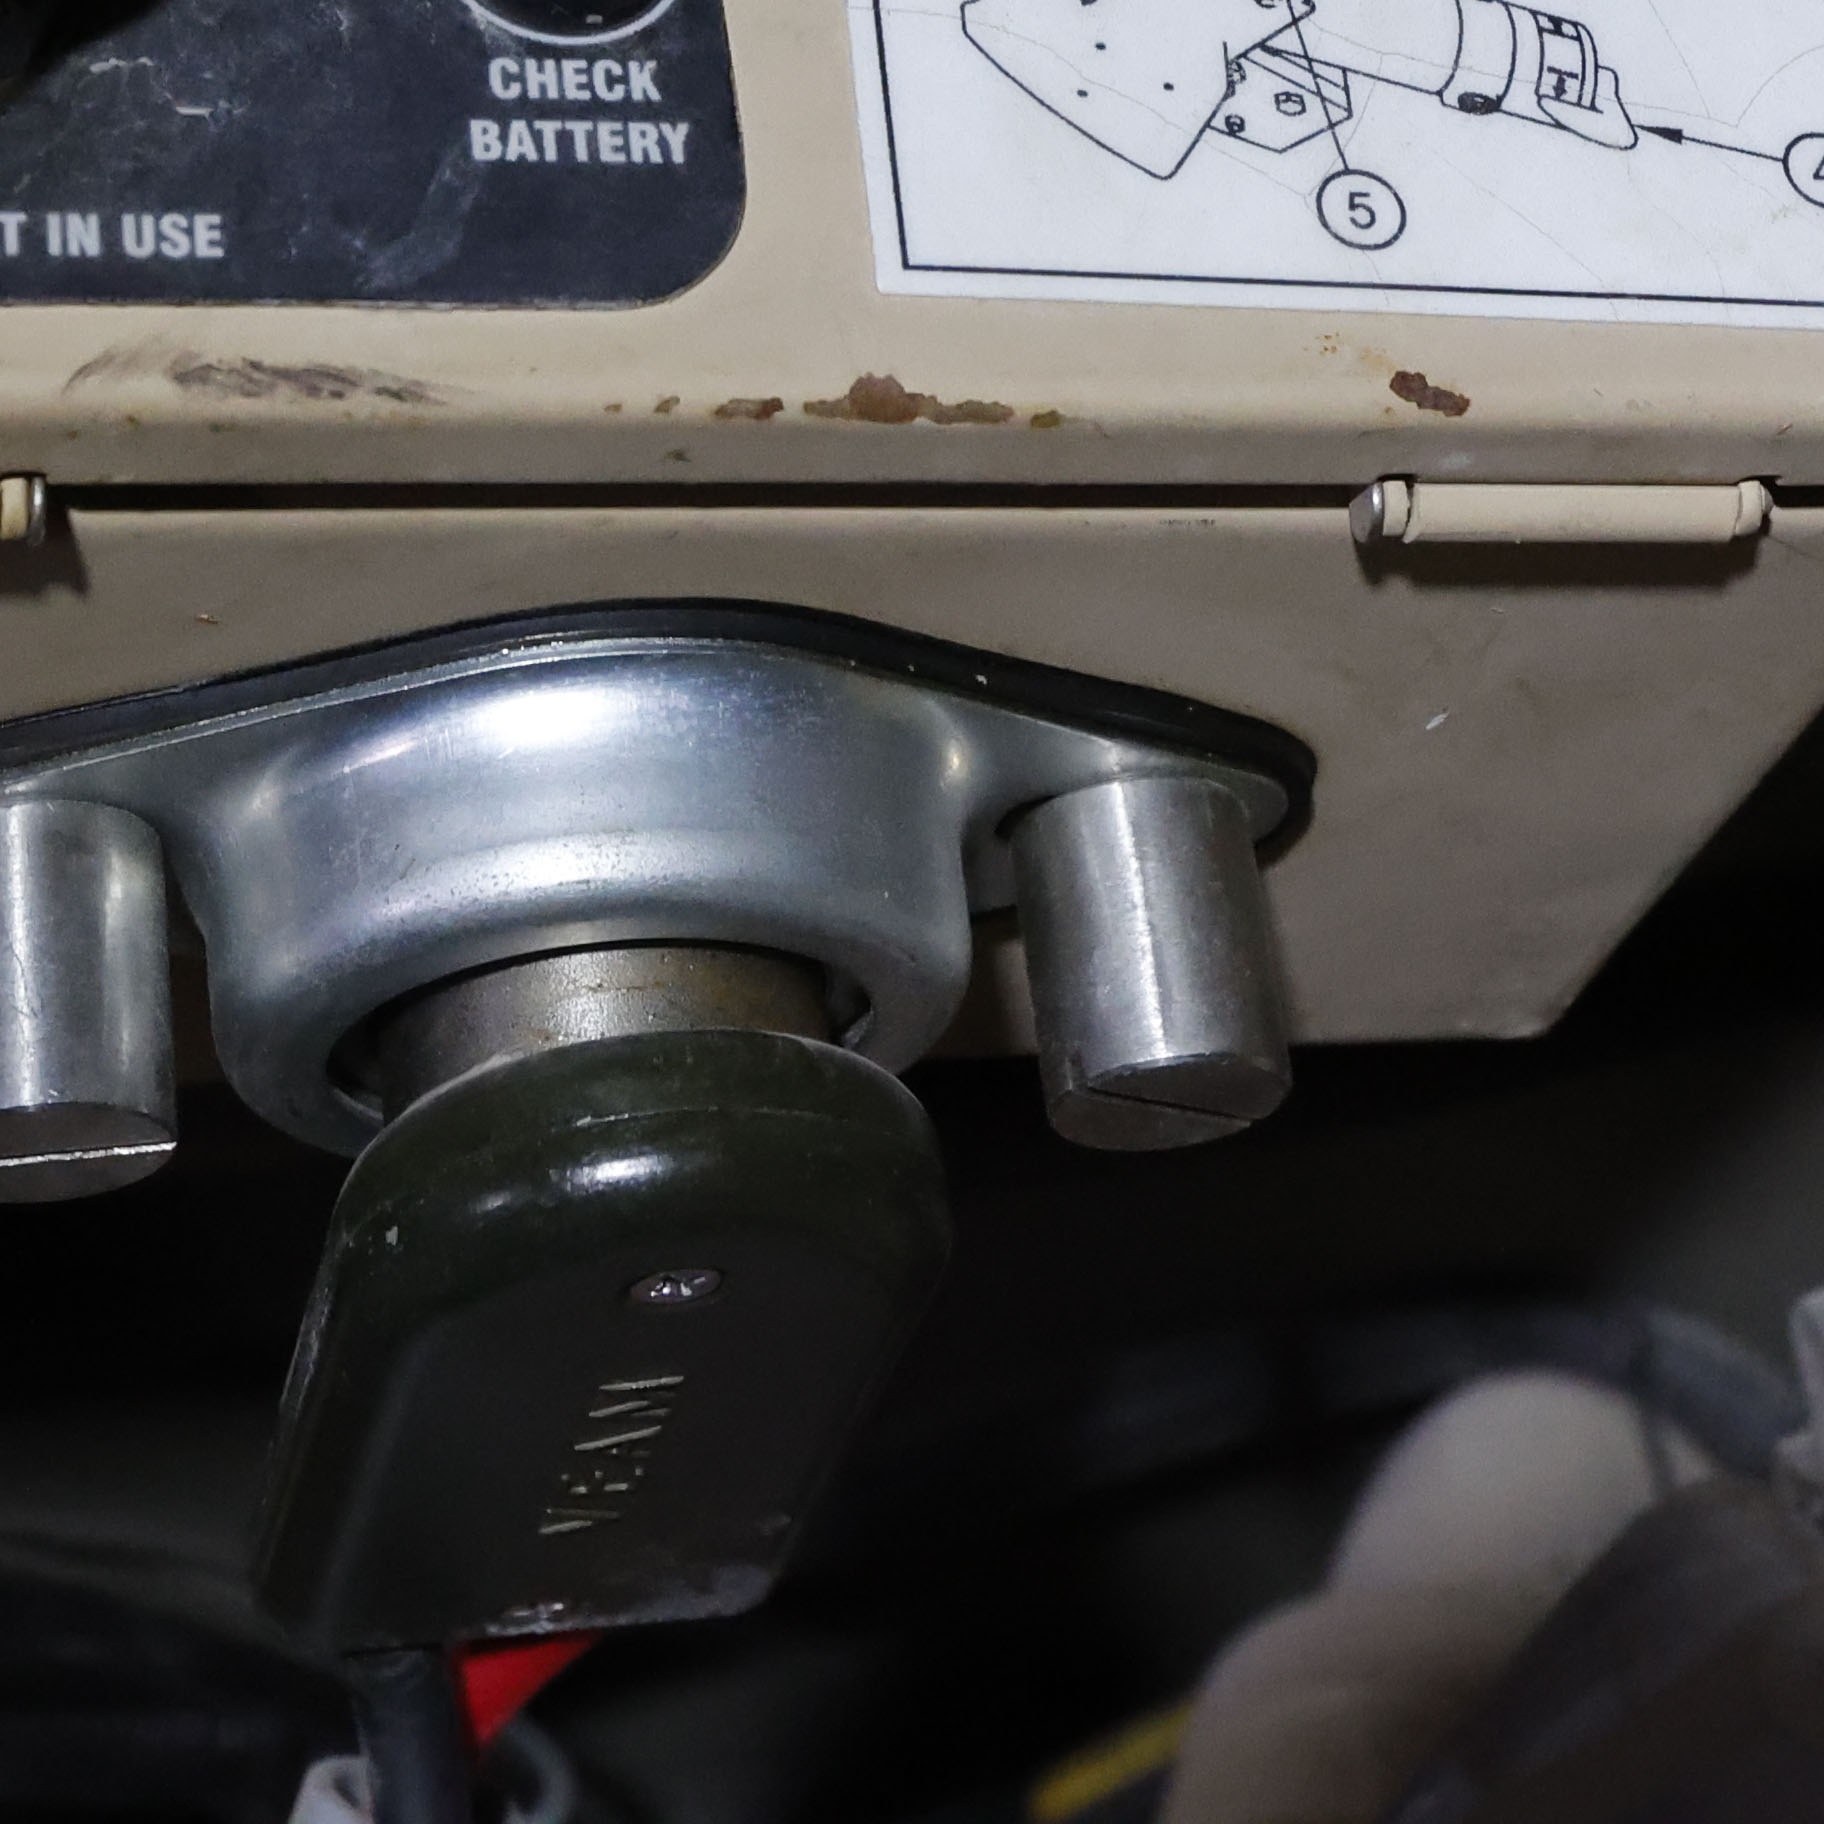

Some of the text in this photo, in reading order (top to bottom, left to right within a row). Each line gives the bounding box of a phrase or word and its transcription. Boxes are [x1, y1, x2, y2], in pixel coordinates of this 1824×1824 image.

[488, 57, 662, 101] CHECK
[469, 119, 690, 164] BATTERY
[1348, 191, 1377, 230] 5
[46, 212, 101, 257] IN
[120, 213, 224, 259] USE
